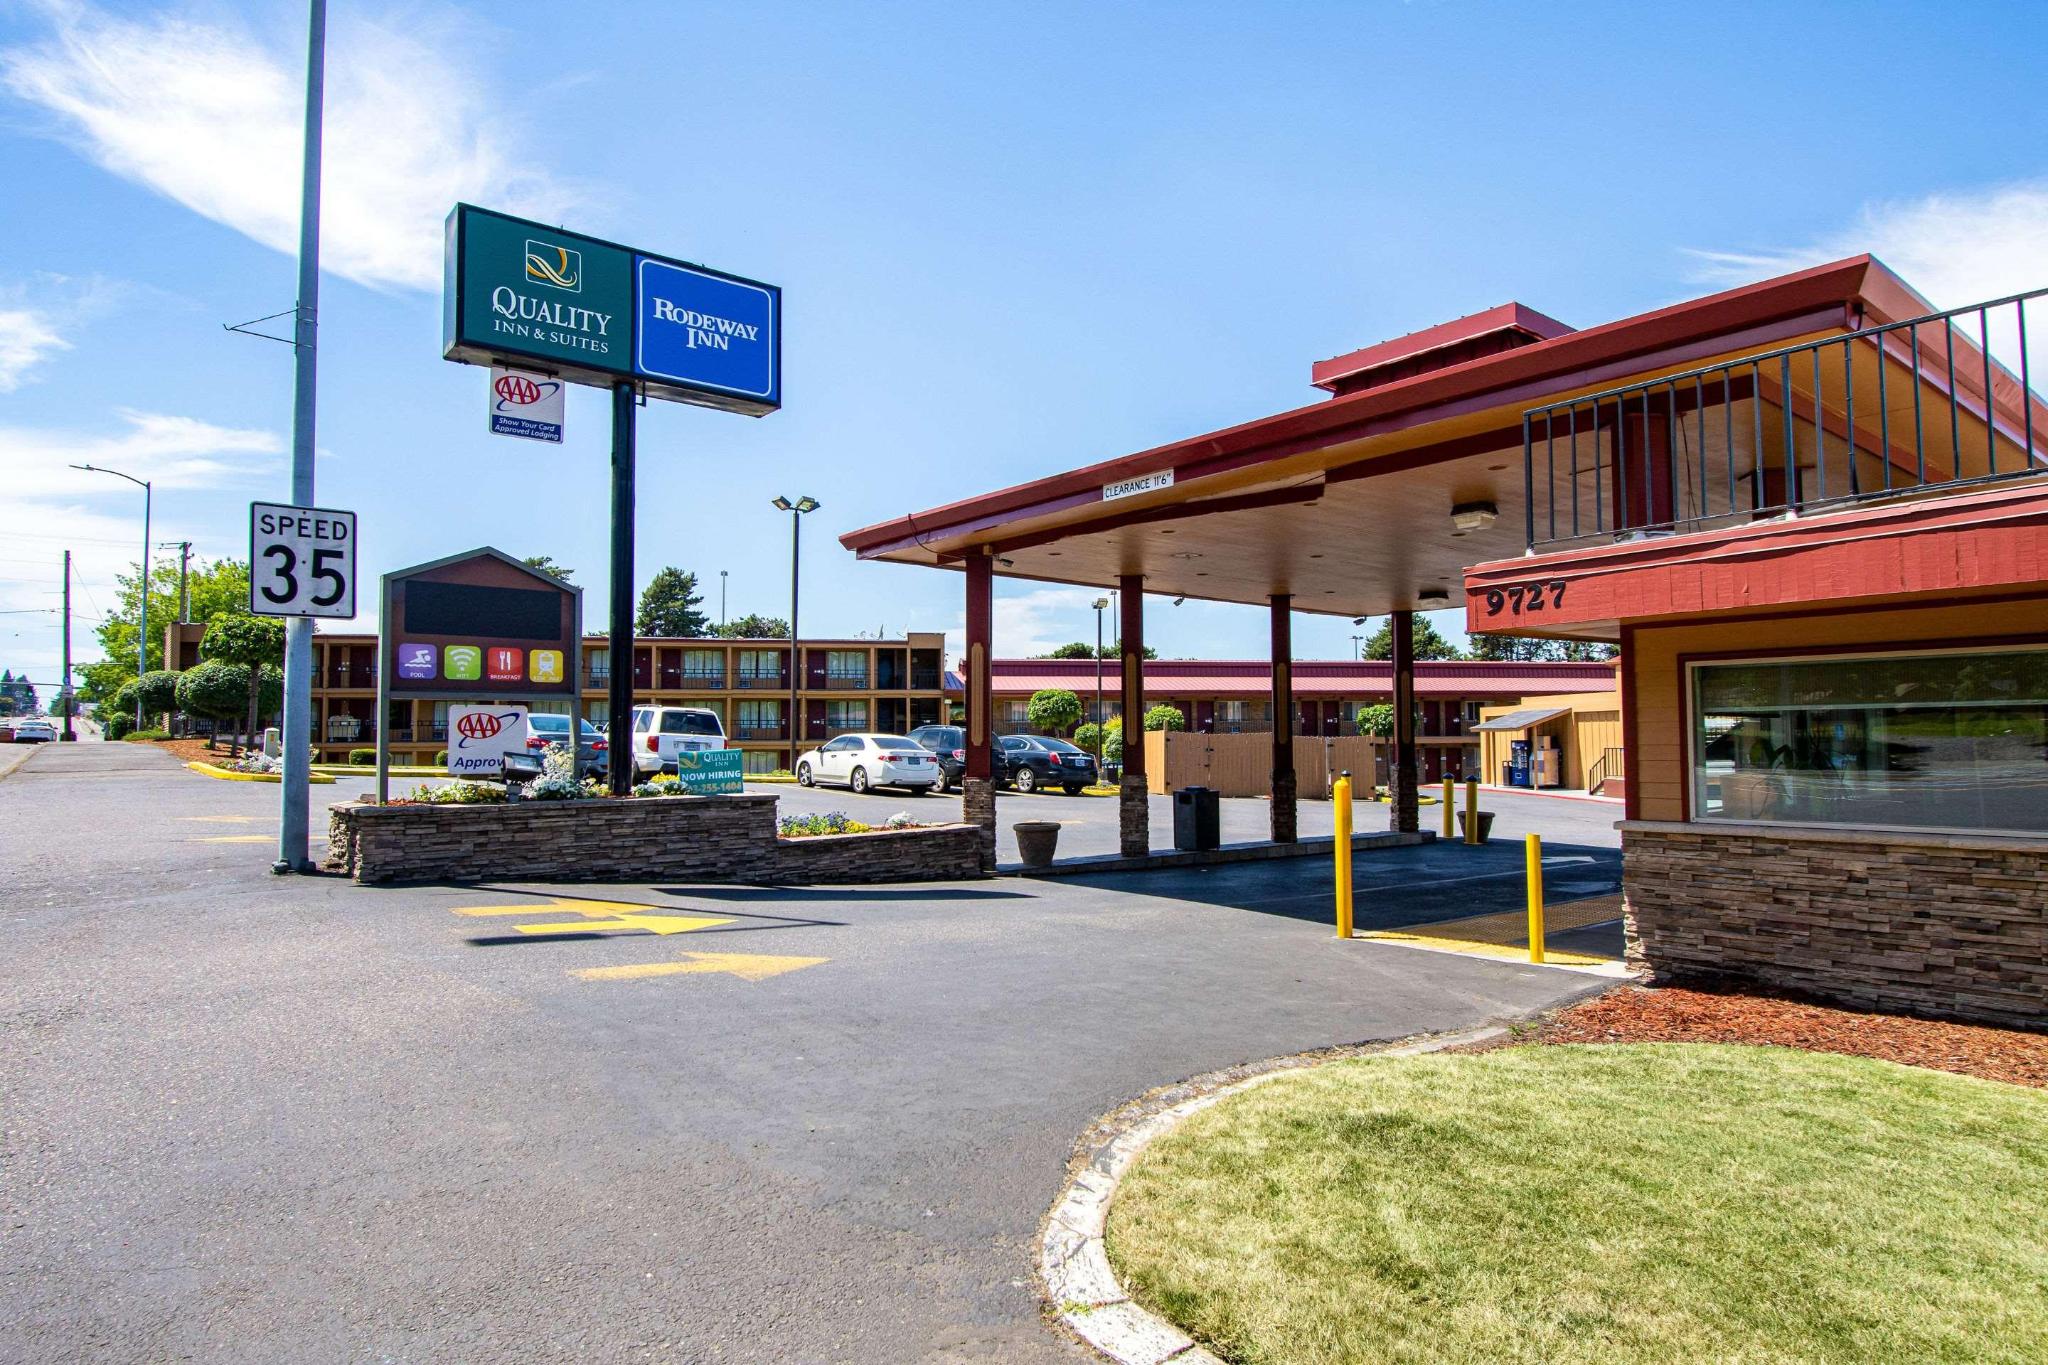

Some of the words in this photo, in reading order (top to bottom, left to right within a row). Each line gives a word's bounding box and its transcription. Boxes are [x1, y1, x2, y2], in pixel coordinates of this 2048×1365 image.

[492, 286, 612, 336] QUALITY
[652, 297, 759, 341] RODEWAY
[493, 320, 529, 337] INN
[533, 328, 546, 341] &
[549, 331, 609, 353] SUITES
[686, 327, 729, 351] INN
[498, 376, 537, 404] AAA
[494, 424, 530, 435] Approved
[530, 429, 559, 440] Lodging
[498, 417, 520, 426] Show
[521, 420, 537, 429] Your
[1105, 478, 1151, 498] CLEARANCE
[260, 514, 348, 540] SPEED
[260, 544, 346, 606] 35
[1486, 580, 1567, 617] 9727
[460, 713, 499, 739] AAA
[454, 757, 504, 770] Approv
[703, 752, 740, 762] QUALITY
[681, 772, 706, 781] NOW
[708, 769, 741, 780] HIRING
